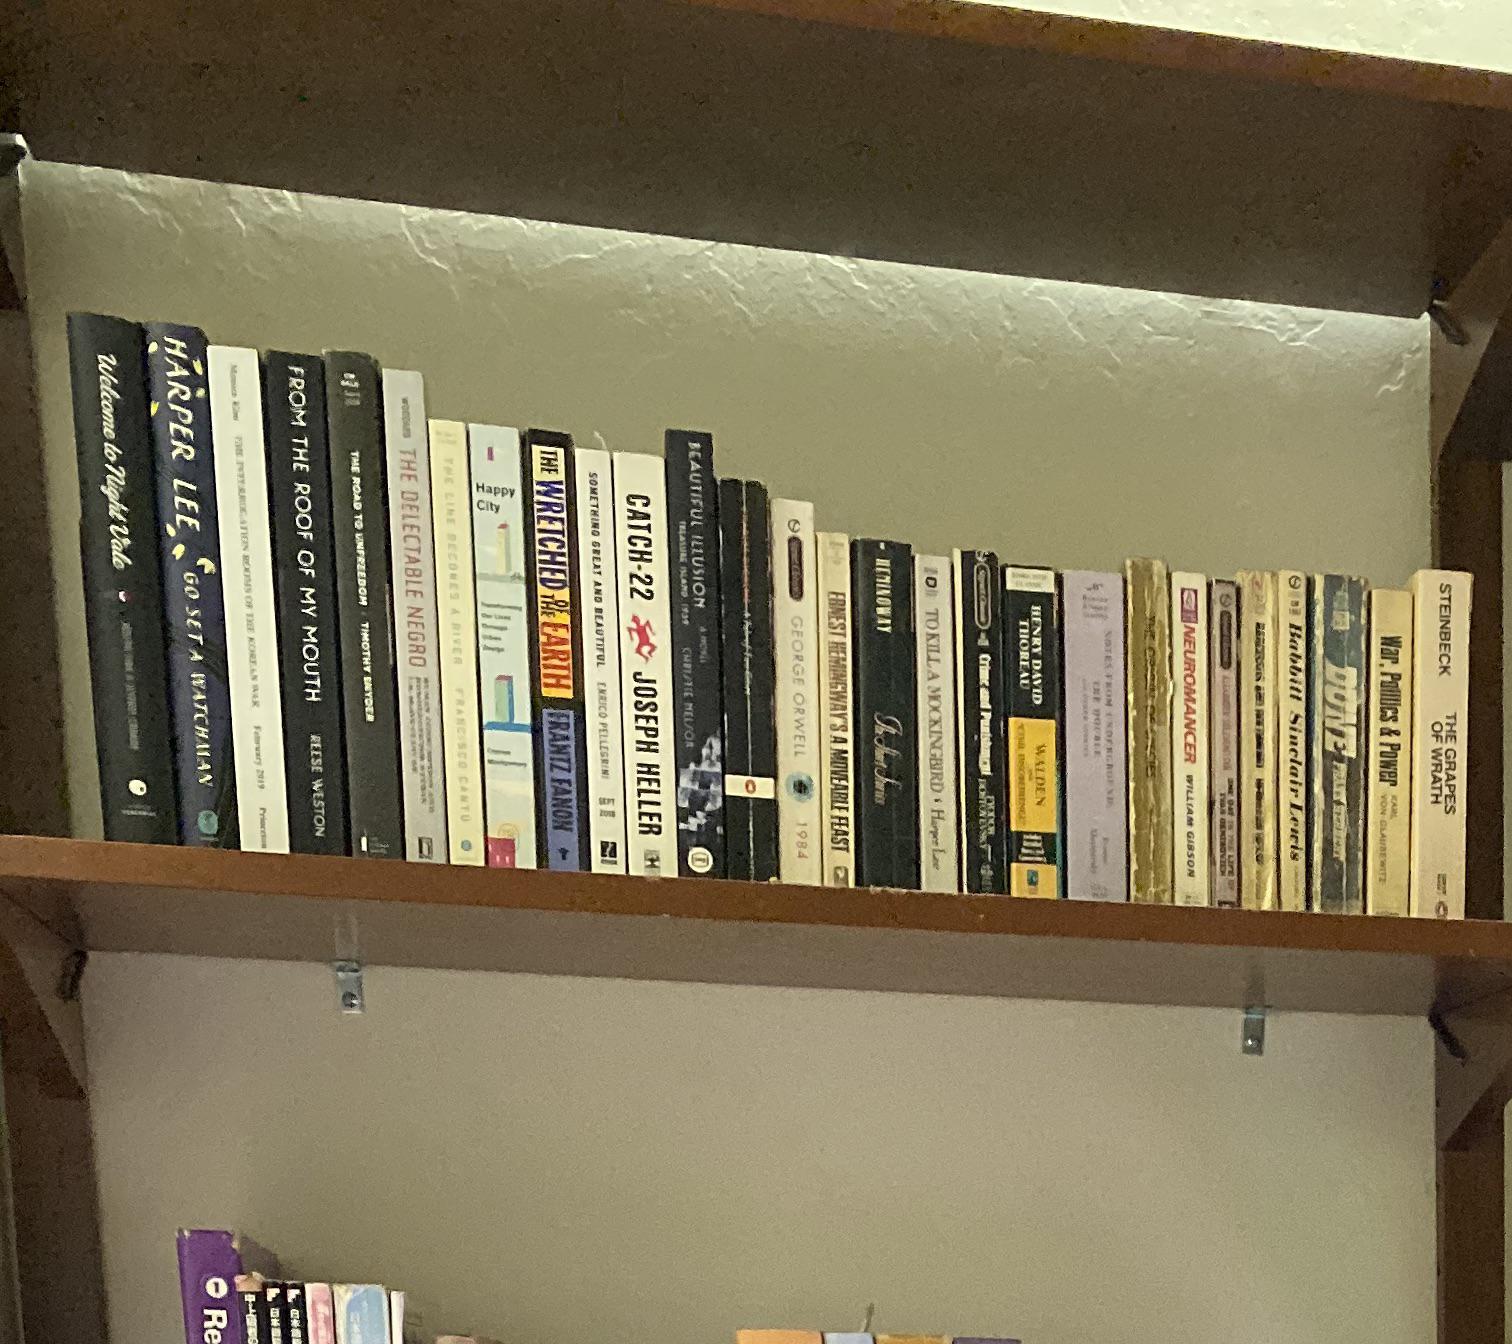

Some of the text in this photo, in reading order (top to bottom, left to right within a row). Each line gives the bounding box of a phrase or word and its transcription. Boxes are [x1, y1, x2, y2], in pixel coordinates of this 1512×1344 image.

[98, 353, 132, 571] Welcome to Night Vale
[163, 336, 200, 532] HARPER LEE
[400, 449, 418, 482] THE
[350, 450, 369, 606] THE ROAD TO UNFREEDOM
[476, 482, 516, 499] Happy
[476, 500, 501, 514] City
[687, 442, 705, 527] BEAUTIFUL
[287, 366, 322, 702] FROM THE ROOF OF MY MOUTH
[401, 489, 422, 597] DELECTABLE
[537, 449, 573, 691] THE WRETCHED EARTH
[588, 472, 607, 669] SOMETHING GREAT AND BEAUTIFUL
[625, 493, 655, 601] CATCH-22
[690, 535, 706, 608] ILLUSION
[405, 605, 428, 668] NEGRO
[827, 591, 847, 637] ERNEST
[875, 558, 892, 633] HEMINGWAY
[1439, 582, 1452, 677] STEINBECK
[183, 571, 214, 787] GO SET A WATCHMAN
[360, 621, 373, 671] TIMOTHY
[790, 615, 804, 685] GEORGE
[827, 641, 849, 732] HEMINGWAY'S
[1019, 618, 1031, 690] THOREAU
[1030, 605, 1043, 705] HENRY DAVID
[1183, 624, 1198, 764] NEUROMANCER
[597, 682, 611, 780] ENRICO PELLEGRINI
[793, 692, 806, 758] ORWELL
[925, 608, 944, 793] TO A MOCKINGBIRD
[1288, 622, 1303, 862] Babbitt Sinclair Lewis
[1379, 635, 1402, 787] War, Politics & Power
[309, 735, 327, 837] REESE WESTON
[547, 710, 574, 832] FRANTZ FANON
[632, 671, 663, 836] JOSEPH HELLER
[830, 748, 849, 811] MOVEABLE
[1035, 743, 1049, 807] WALDEN
[1431, 720, 1443, 806] OF WRATH
[1444, 712, 1457, 815] THE GRAPES
[797, 822, 809, 859] 1984
[831, 816, 850, 853] FEAST
[1186, 774, 1197, 878] WILLIAM GIBSON
